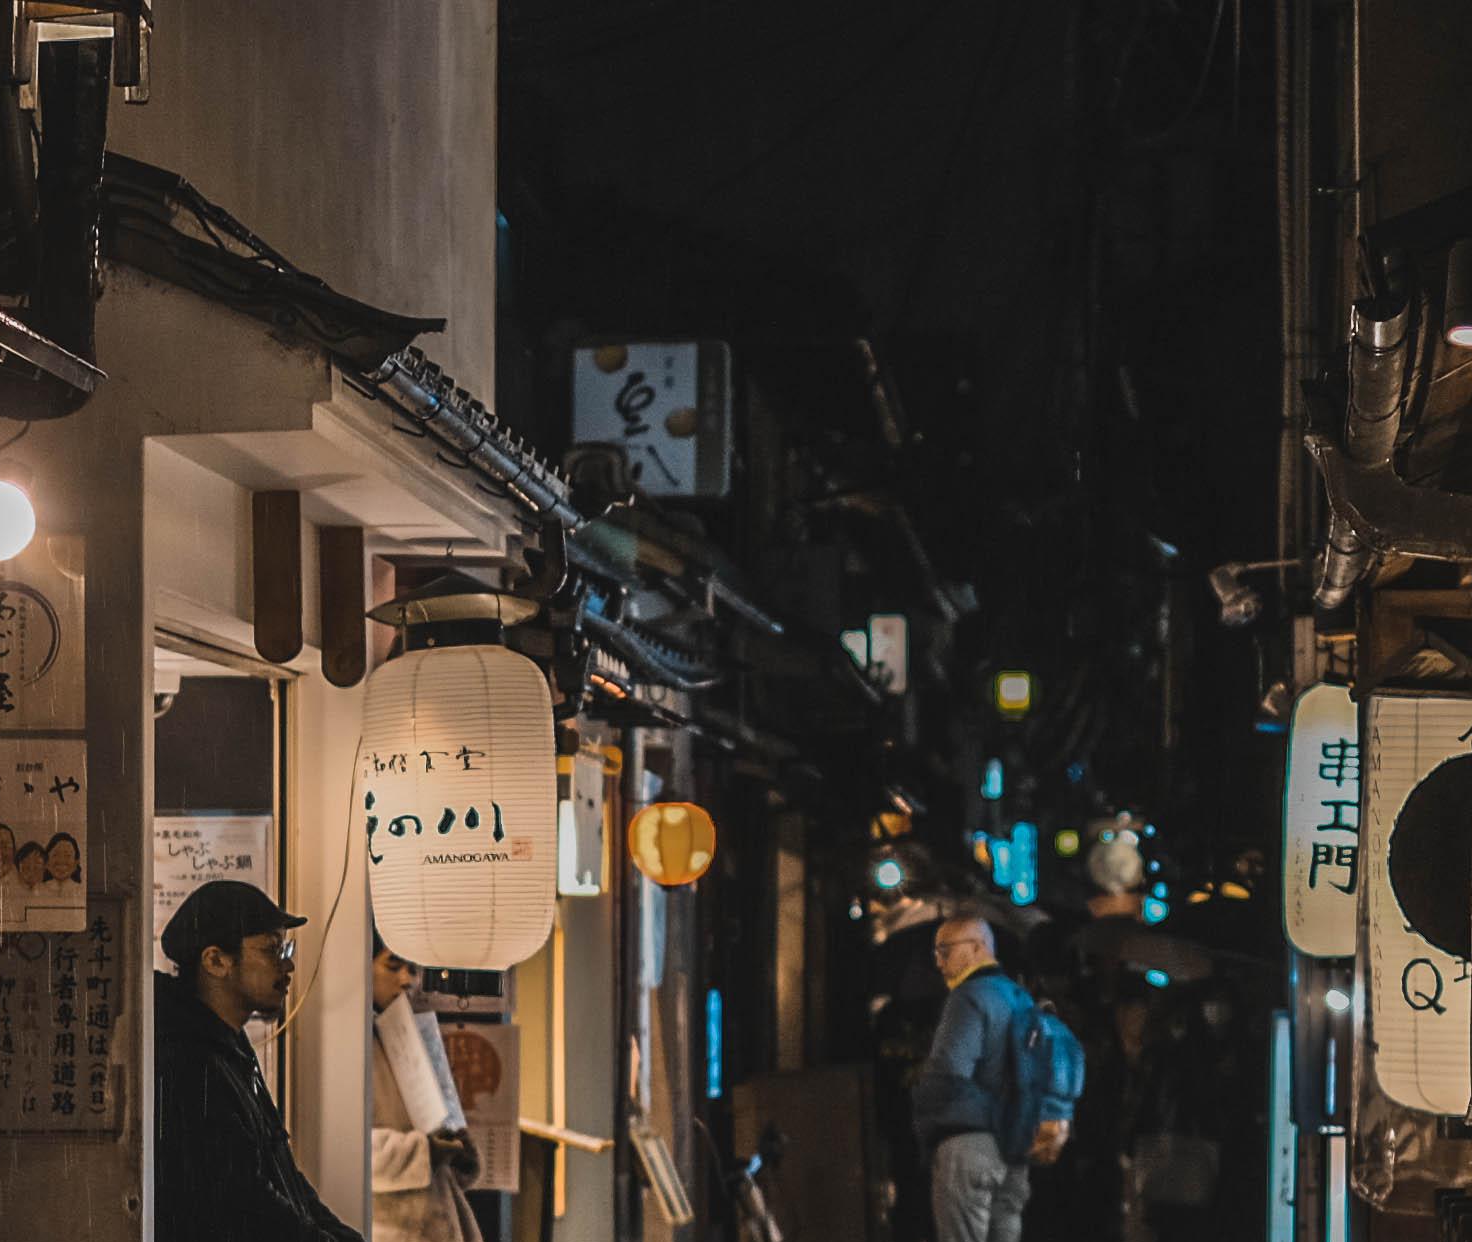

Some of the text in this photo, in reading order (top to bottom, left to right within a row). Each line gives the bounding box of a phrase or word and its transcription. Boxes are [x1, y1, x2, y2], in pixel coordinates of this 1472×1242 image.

[423, 852, 511, 864] AMANOGAWA
[51, 933, 79, 1116] 行者専用道路
